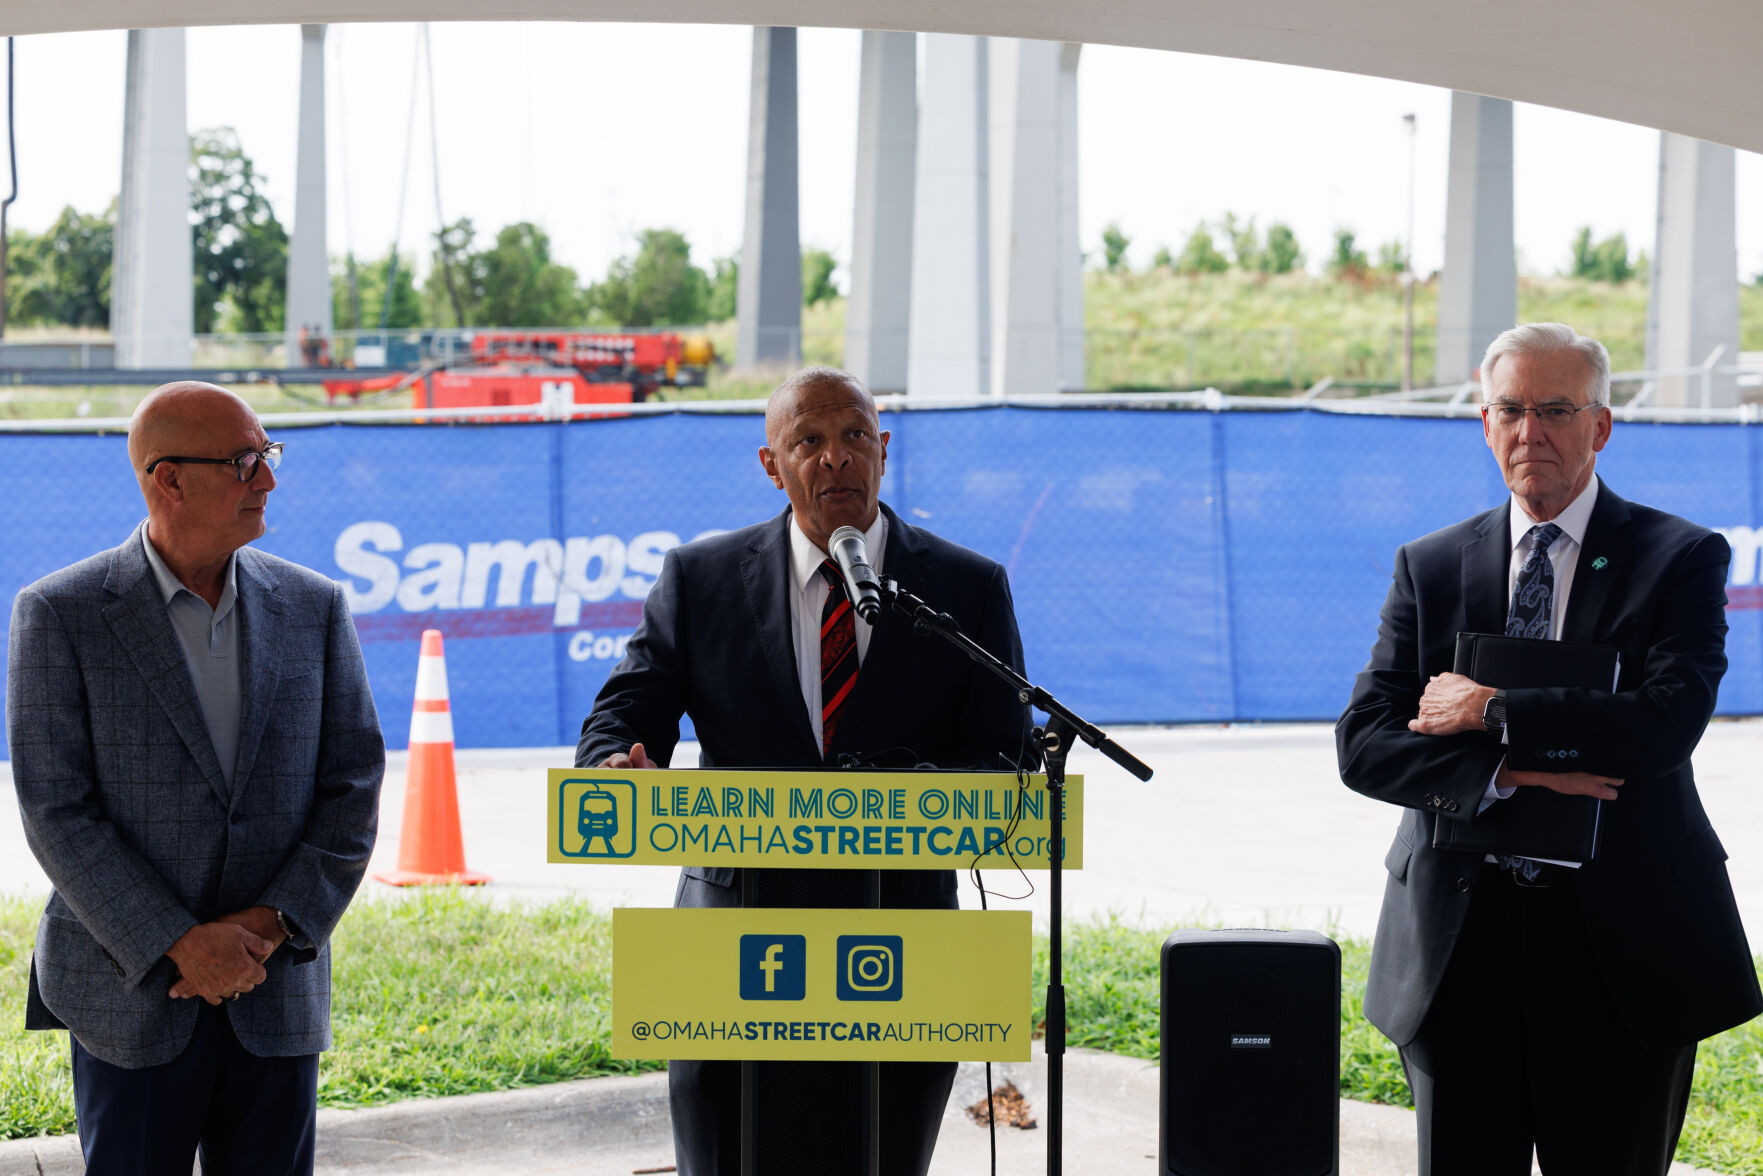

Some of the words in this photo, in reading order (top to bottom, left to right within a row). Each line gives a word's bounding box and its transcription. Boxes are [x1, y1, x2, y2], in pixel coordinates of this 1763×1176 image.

[334, 521, 733, 627] Samps
[652, 786, 774, 818] LEARN
[789, 788, 906, 820] MORE
[631, 1021, 1012, 1042] @OMAHASTREETCARAUTHORITY
